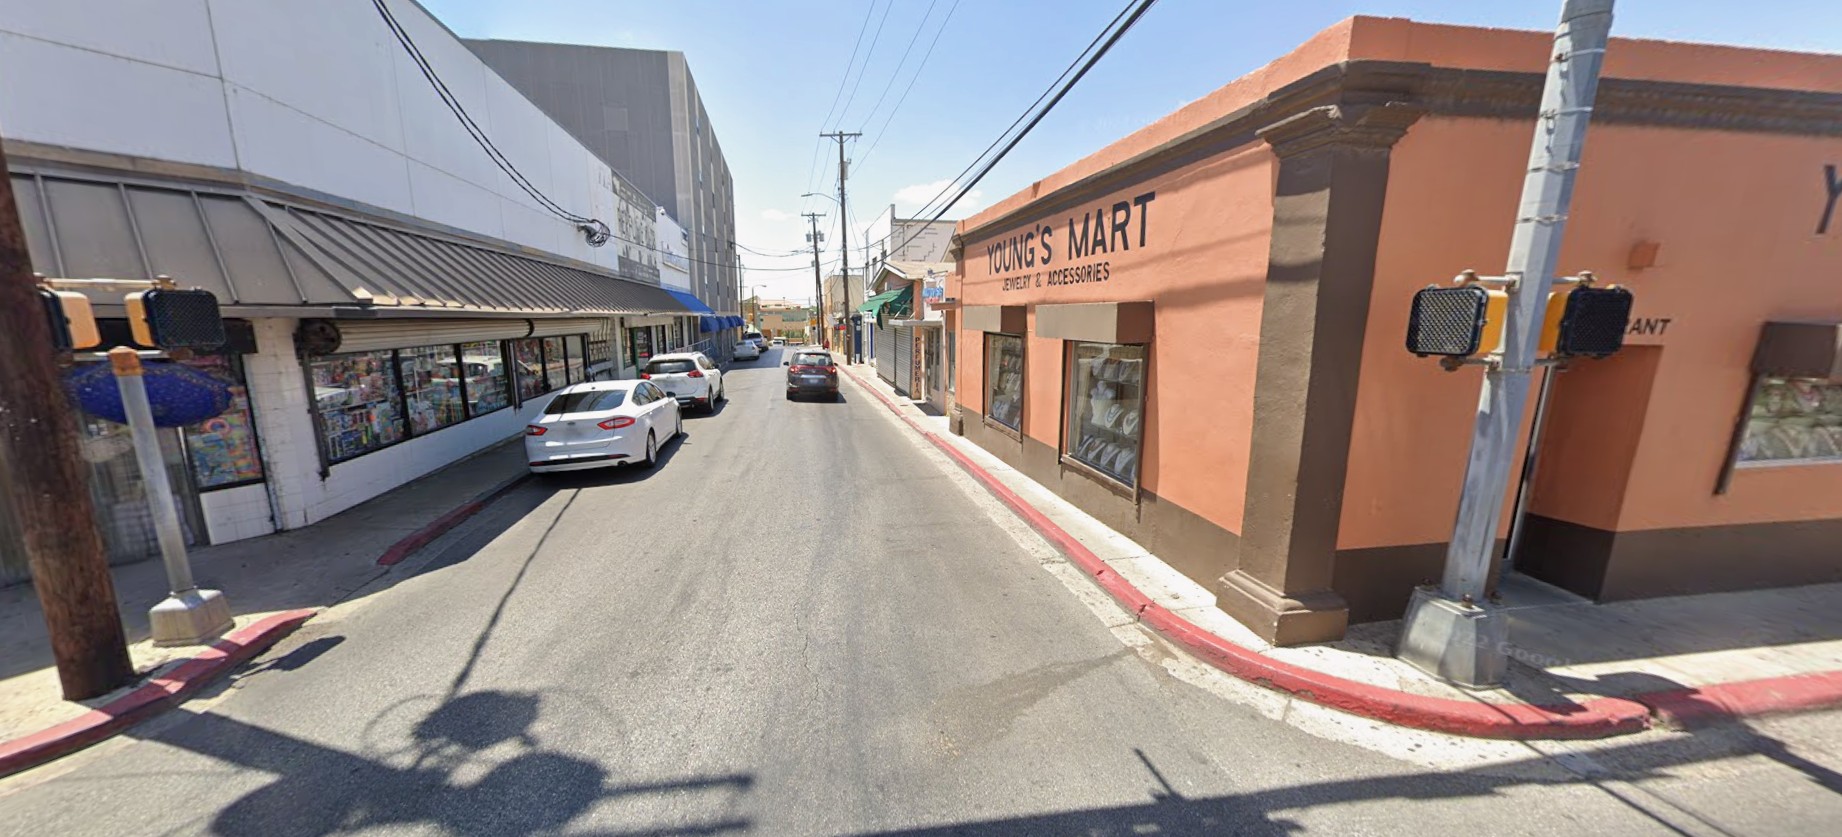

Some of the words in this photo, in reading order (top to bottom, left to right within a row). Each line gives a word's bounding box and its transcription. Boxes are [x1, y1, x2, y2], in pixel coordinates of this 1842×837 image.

[987, 223, 1053, 276] YOUNG'S
[1068, 191, 1156, 260] MART
[1002, 273, 1032, 292] JEWELRY
[1035, 272, 1042, 288] &
[1047, 261, 1110, 286] ACCESSORIES
[1624, 318, 1671, 335] ANT
